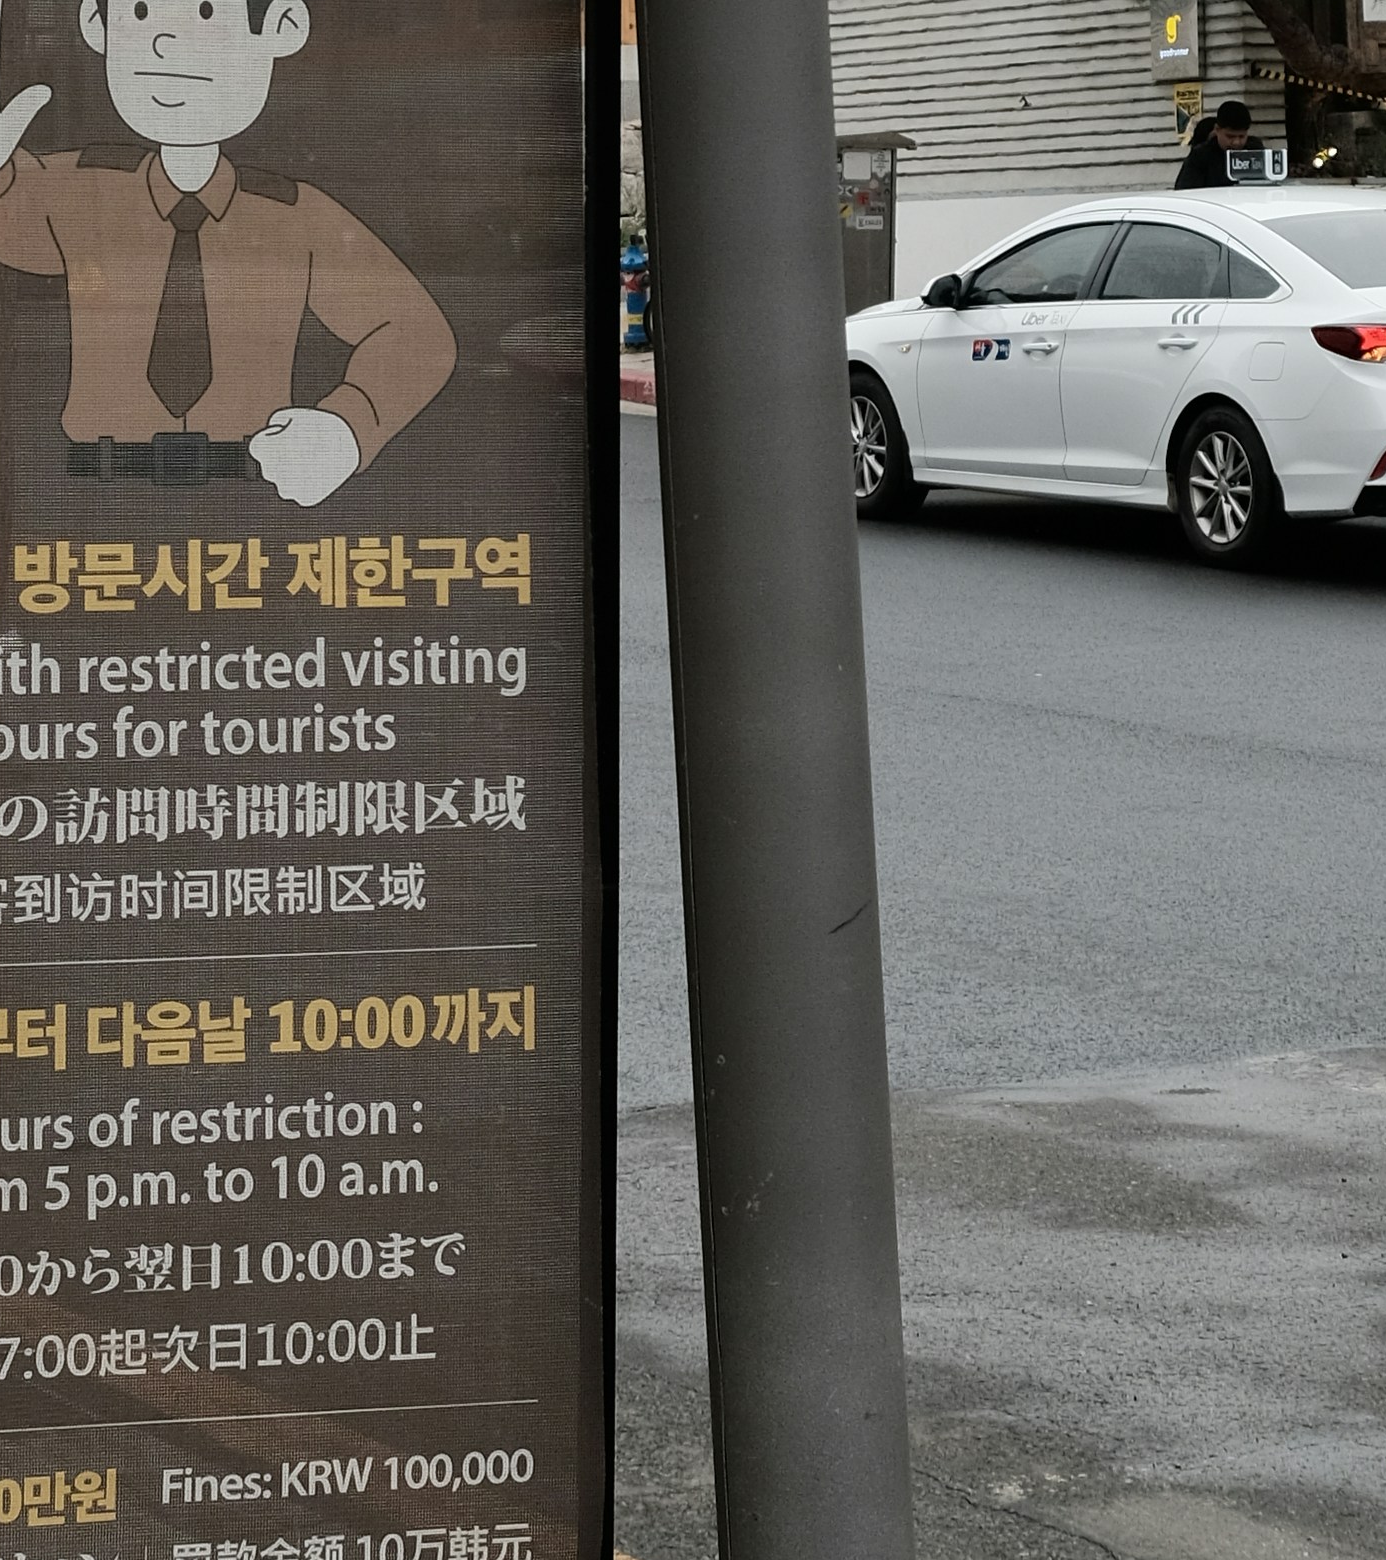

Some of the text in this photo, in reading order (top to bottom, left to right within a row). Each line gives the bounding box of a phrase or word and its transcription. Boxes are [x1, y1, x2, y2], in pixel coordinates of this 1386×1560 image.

[1232, 157, 1251, 170] Uber
[14, 539, 269, 613] 방문시간
[286, 534, 530, 608] 제한구역
[79, 637, 325, 693] restricted
[342, 636, 526, 696] visiting
[114, 706, 188, 759] for
[200, 703, 396, 755] tourists
[88, 996, 251, 1068] 다음날
[269, 986, 535, 1054] 10:00까지
[89, 1098, 139, 1147] of
[153, 1092, 396, 1144] restriction
[45, 1166, 70, 1210] 5
[88, 1172, 190, 1220] p.m.
[204, 1162, 253, 1202] to
[272, 1154, 325, 1198] 10
[340, 1160, 438, 1196] a.m.
[163, 1449, 533, 1504] Fines: KRW 100,000
